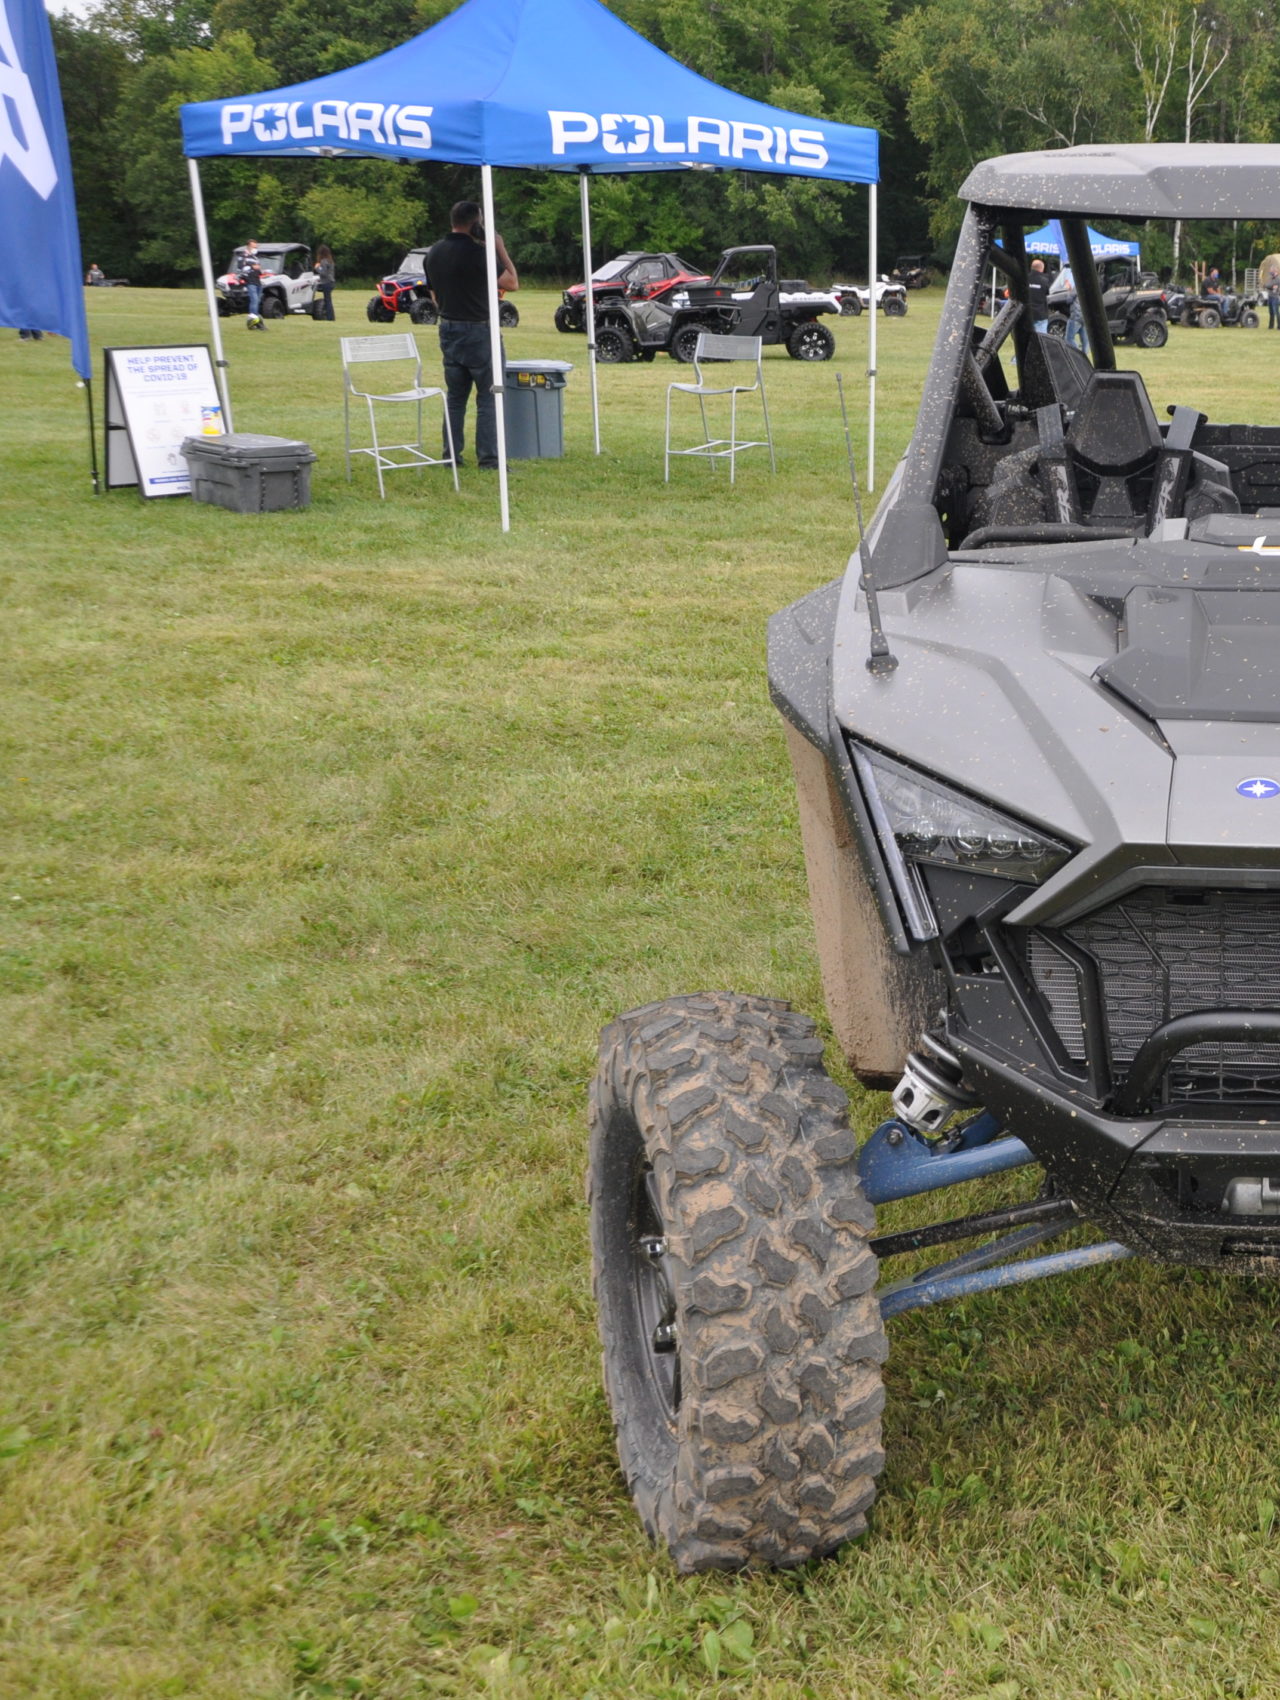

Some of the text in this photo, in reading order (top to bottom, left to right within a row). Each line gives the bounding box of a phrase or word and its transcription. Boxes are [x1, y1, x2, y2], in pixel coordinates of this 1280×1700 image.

[221, 100, 433, 149] POLARIS
[548, 111, 829, 169] POLARIS
[1025, 241, 1060, 254] LARIS
[1091, 243, 1130, 254] OLARIS
[127, 355, 194, 365] HELP PREVENT
[127, 363, 198, 374] THE SPREAD OF
[143, 373, 187, 382] COVID-19
